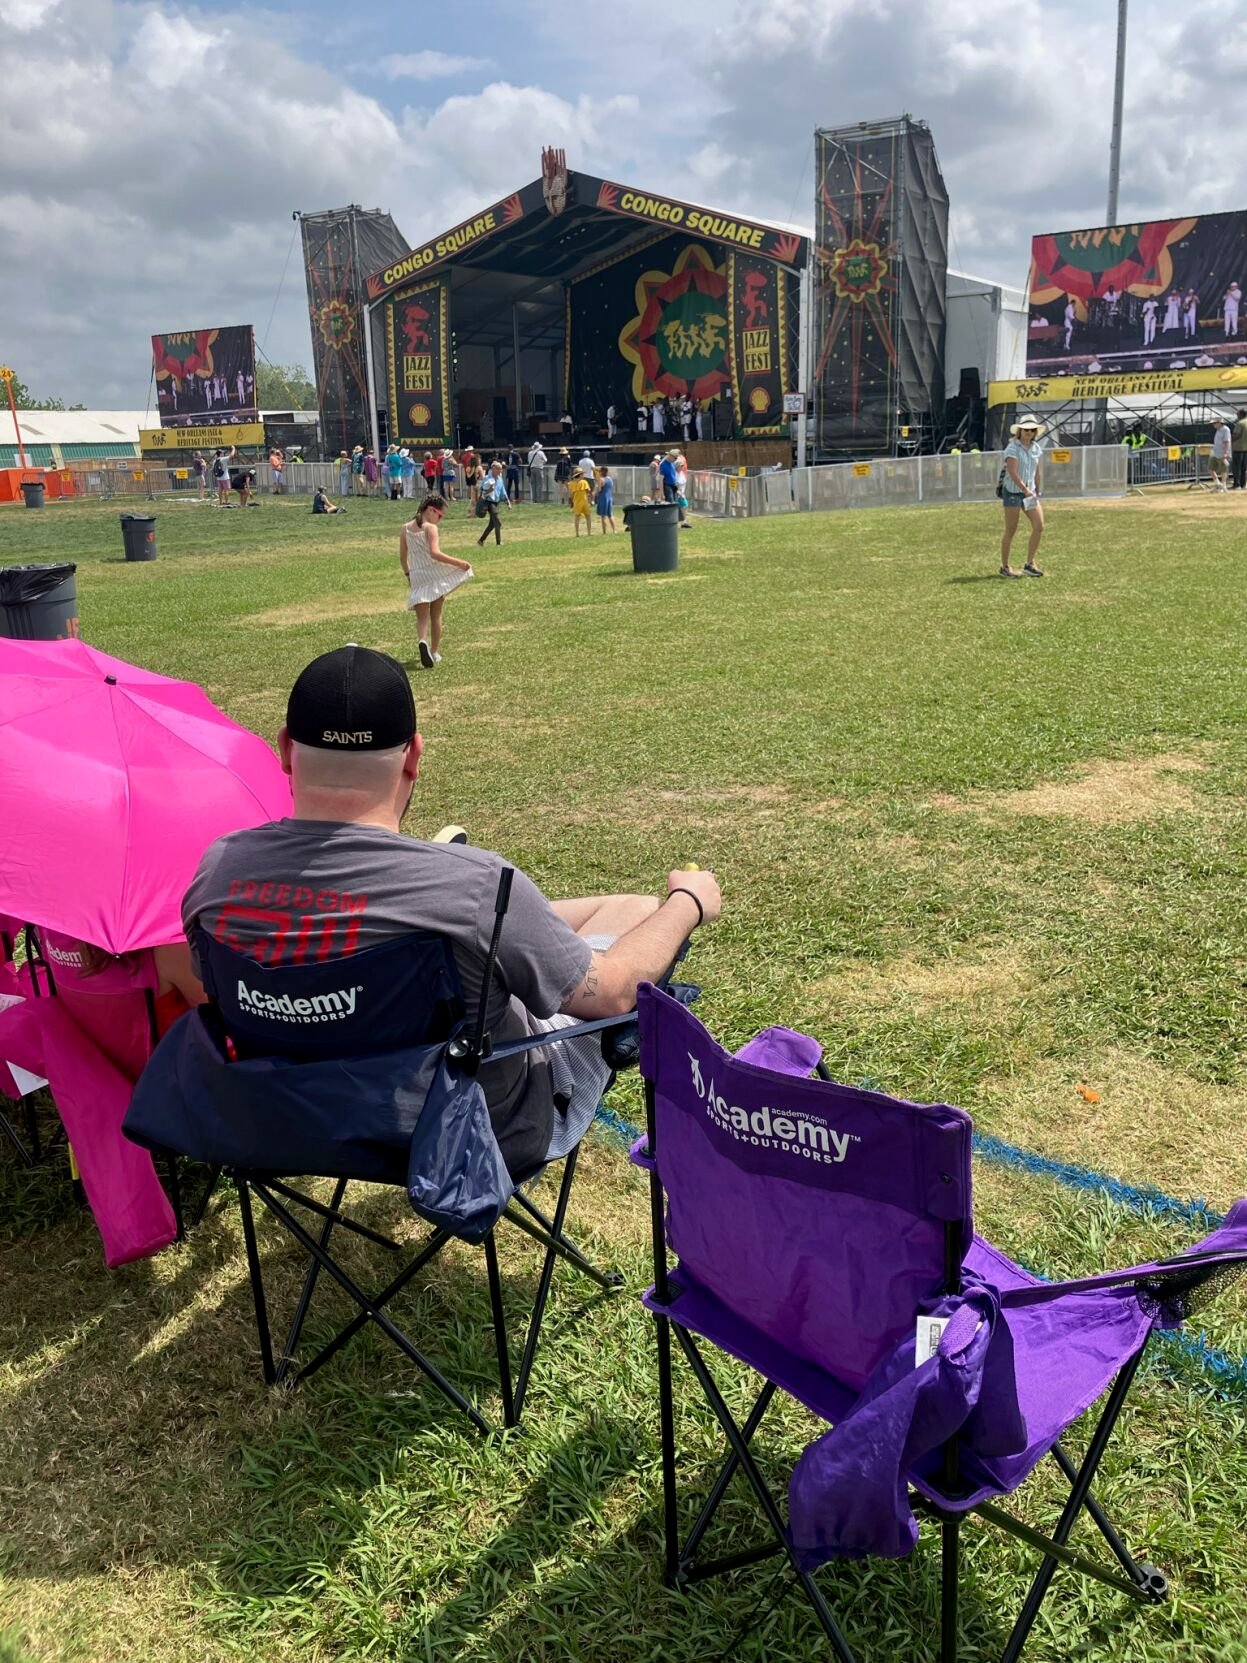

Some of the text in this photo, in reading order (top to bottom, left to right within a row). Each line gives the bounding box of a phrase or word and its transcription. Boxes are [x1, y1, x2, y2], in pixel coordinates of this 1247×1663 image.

[620, 193, 766, 248] CONGO SQUARE
[383, 212, 496, 284] CONGO SQUARE
[744, 330, 769, 351] JAZZ
[405, 356, 430, 373] JAZZ
[745, 352, 769, 370] FEST
[405, 374, 430, 389] FEST
[1072, 378, 1184, 398] HERITAGE FESTIVAL
[322, 730, 373, 744] SAINTS
[227, 879, 369, 914] FREEDOM
[237, 980, 357, 1015] Academy
[239, 1002, 346, 1024] SPORTS+OUTDOORS
[707, 1076, 850, 1163] Academy
[771, 1106, 828, 1126] academy.com
[706, 1104, 833, 1164] SPORTS+OUTDOORS
